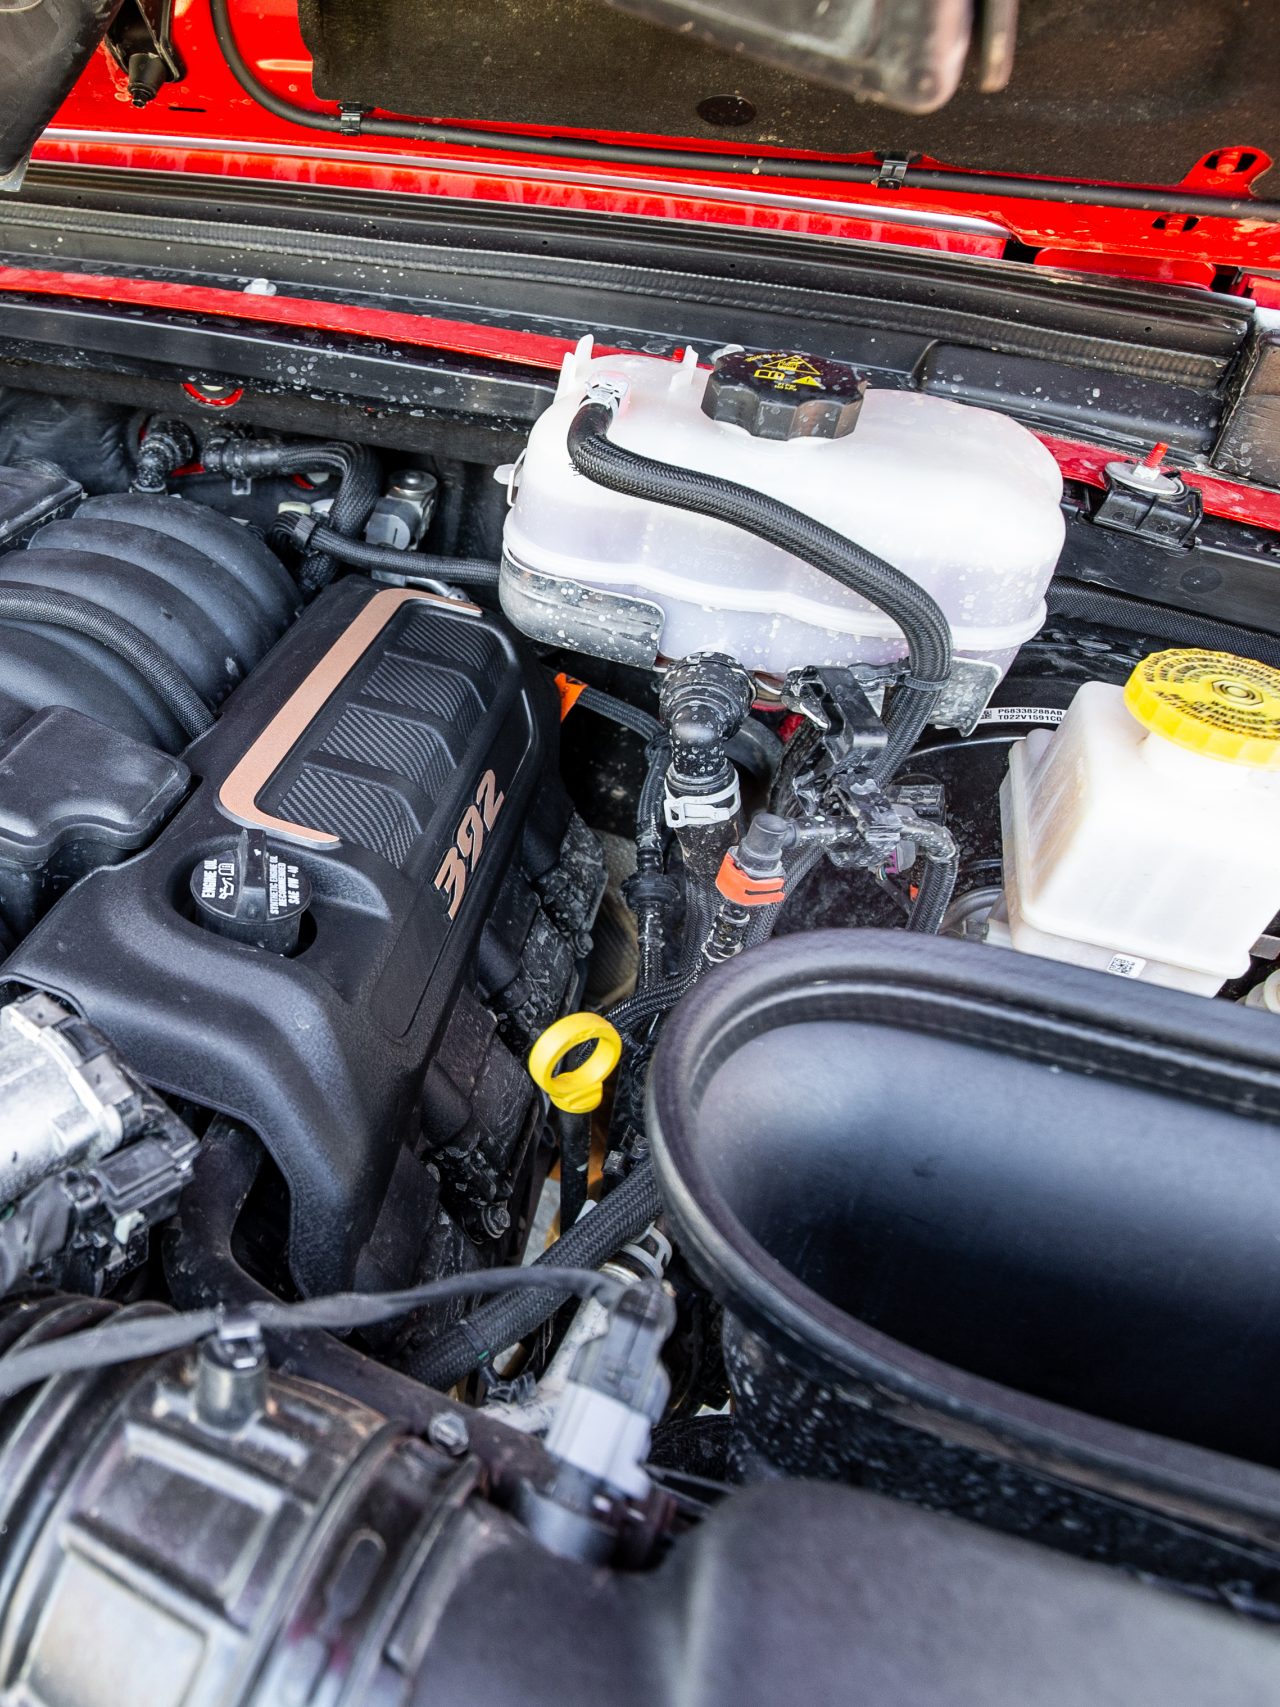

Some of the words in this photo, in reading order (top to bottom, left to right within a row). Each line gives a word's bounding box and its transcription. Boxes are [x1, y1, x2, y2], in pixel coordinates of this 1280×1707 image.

[432, 768, 505, 921] 392
[203, 859, 218, 870] OIL
[269, 864, 279, 883] ENGINE
[202, 870, 217, 898] ENGINE
[278, 862, 288, 907] RECOMMENDED
[287, 891, 301, 905] SAE
[269, 883, 279, 915] SYNTHETIC
